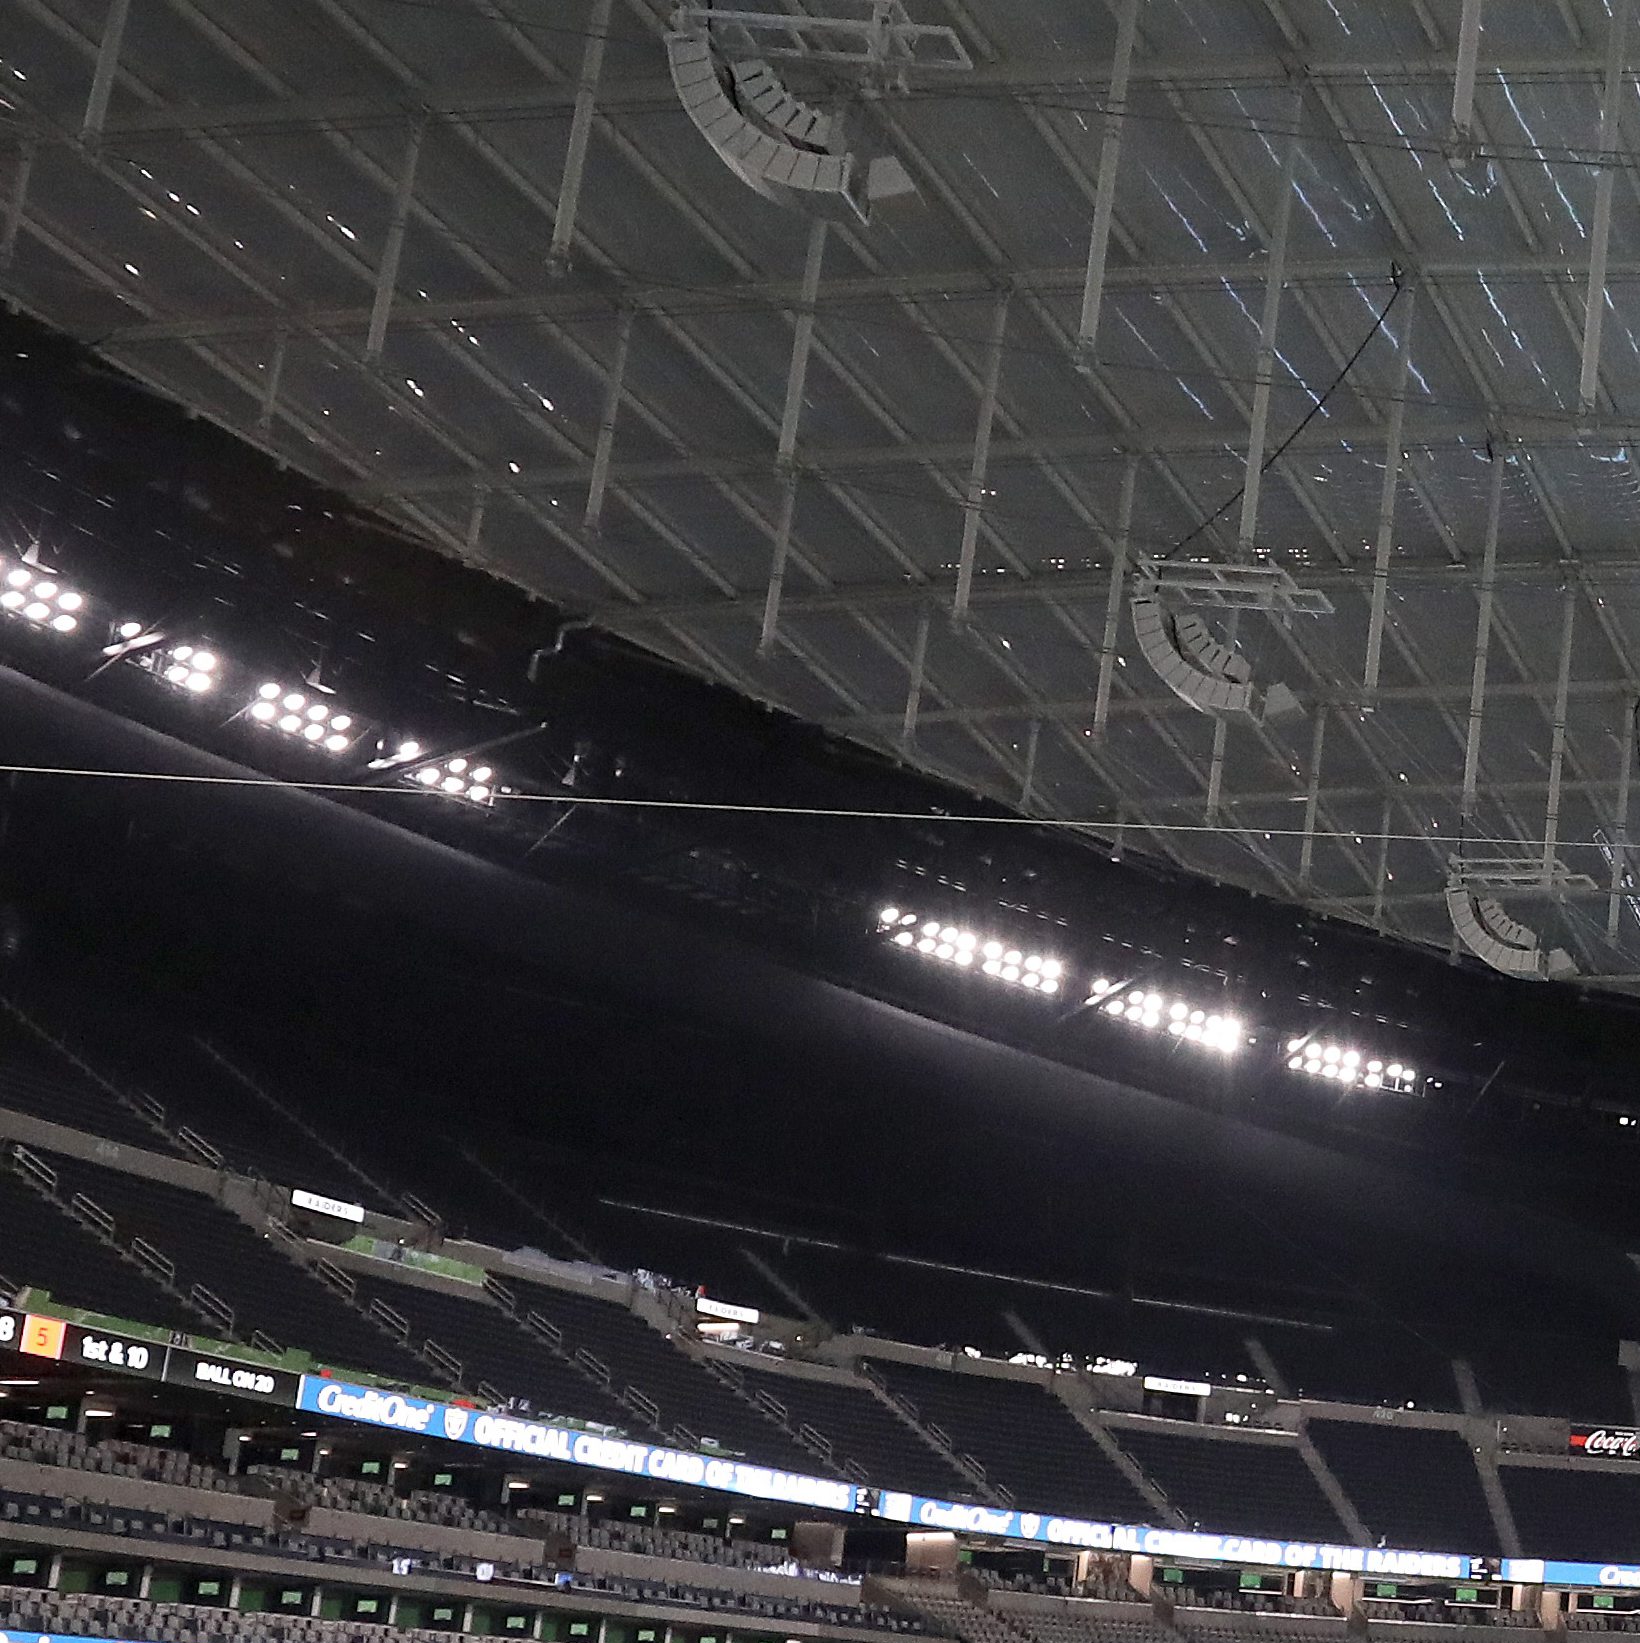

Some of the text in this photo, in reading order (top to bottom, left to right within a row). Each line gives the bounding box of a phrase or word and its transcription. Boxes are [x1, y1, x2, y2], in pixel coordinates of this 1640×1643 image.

[36, 1327, 50, 1347] 5
[82, 1336, 149, 1369] 1st & 10
[195, 1362, 275, 1393] BALL ON 20
[474, 1415, 572, 1460] OFFICIAL
[649, 1449, 705, 1483] CARD
[705, 1461, 735, 1488] OF
[1047, 1519, 1139, 1551] OFFICIAL
[1221, 1540, 1281, 1564] CARD
[1284, 1544, 1317, 1567] OF
